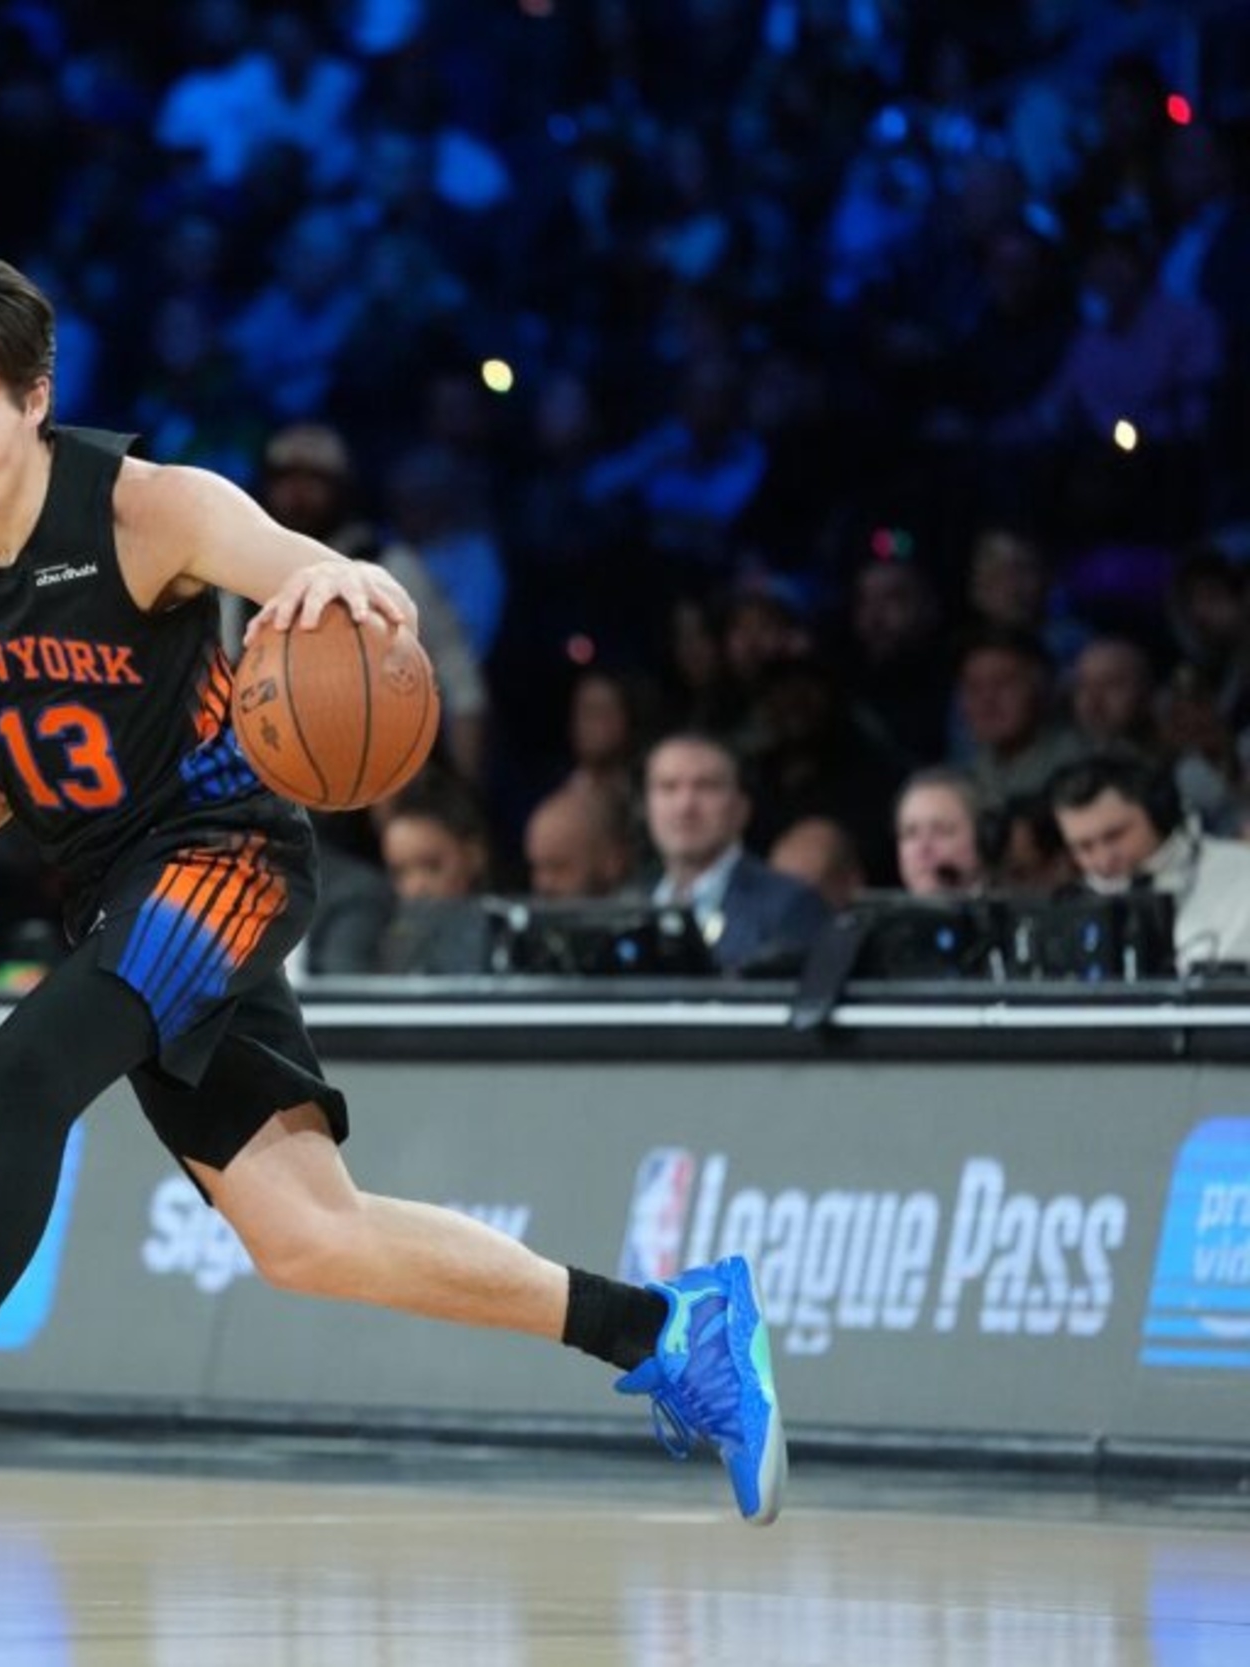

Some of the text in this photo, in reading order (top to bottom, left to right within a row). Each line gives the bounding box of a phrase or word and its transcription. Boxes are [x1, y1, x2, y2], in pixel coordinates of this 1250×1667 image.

[6, 635, 143, 685] YORK
[687, 1152, 1128, 1355] League Pass
